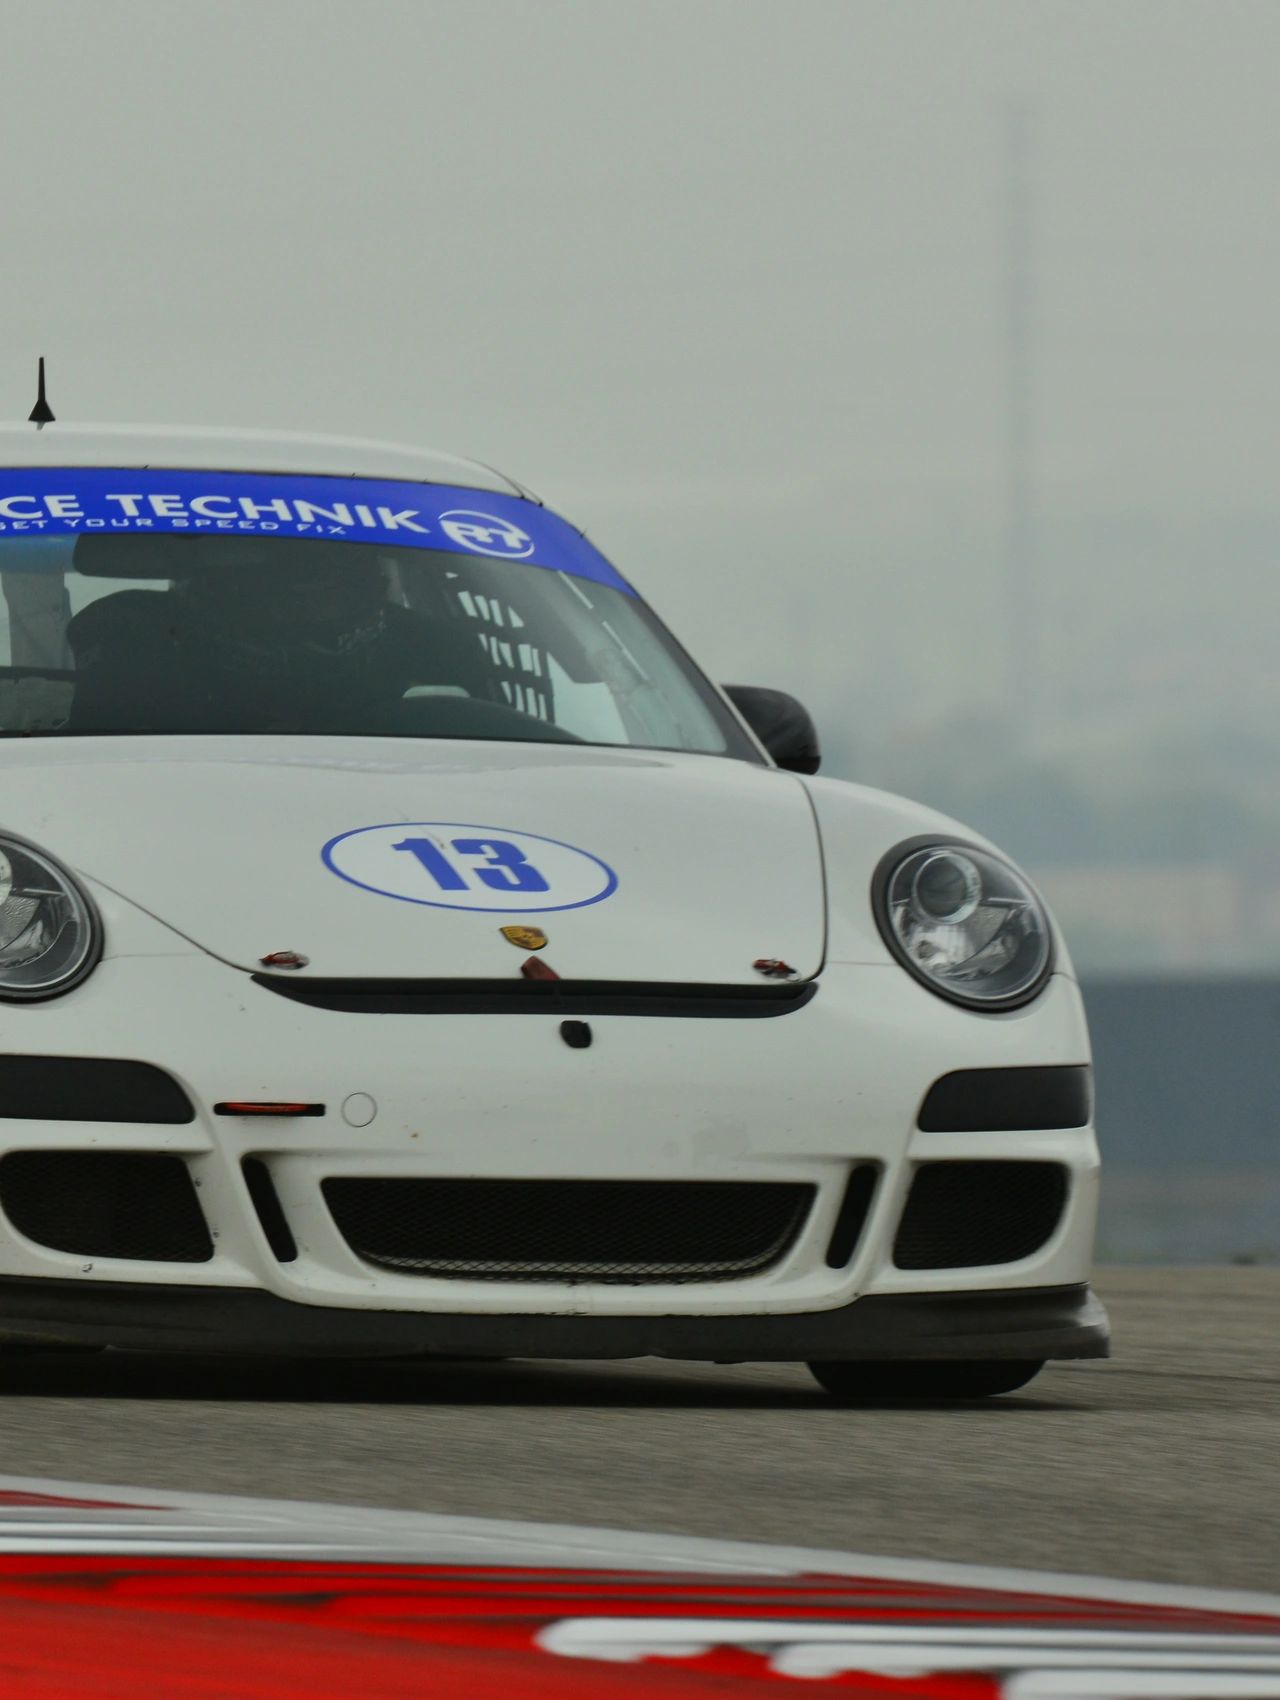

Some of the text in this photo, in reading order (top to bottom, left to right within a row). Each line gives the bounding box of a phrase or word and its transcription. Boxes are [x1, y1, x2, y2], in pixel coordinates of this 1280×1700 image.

[64, 518, 154, 528] YOUR
[171, 518, 280, 531] SPEED
[296, 523, 347, 535] FIX
[105, 494, 431, 534] TECHNIK
[439, 514, 534, 555] RT
[391, 837, 551, 893] 13
